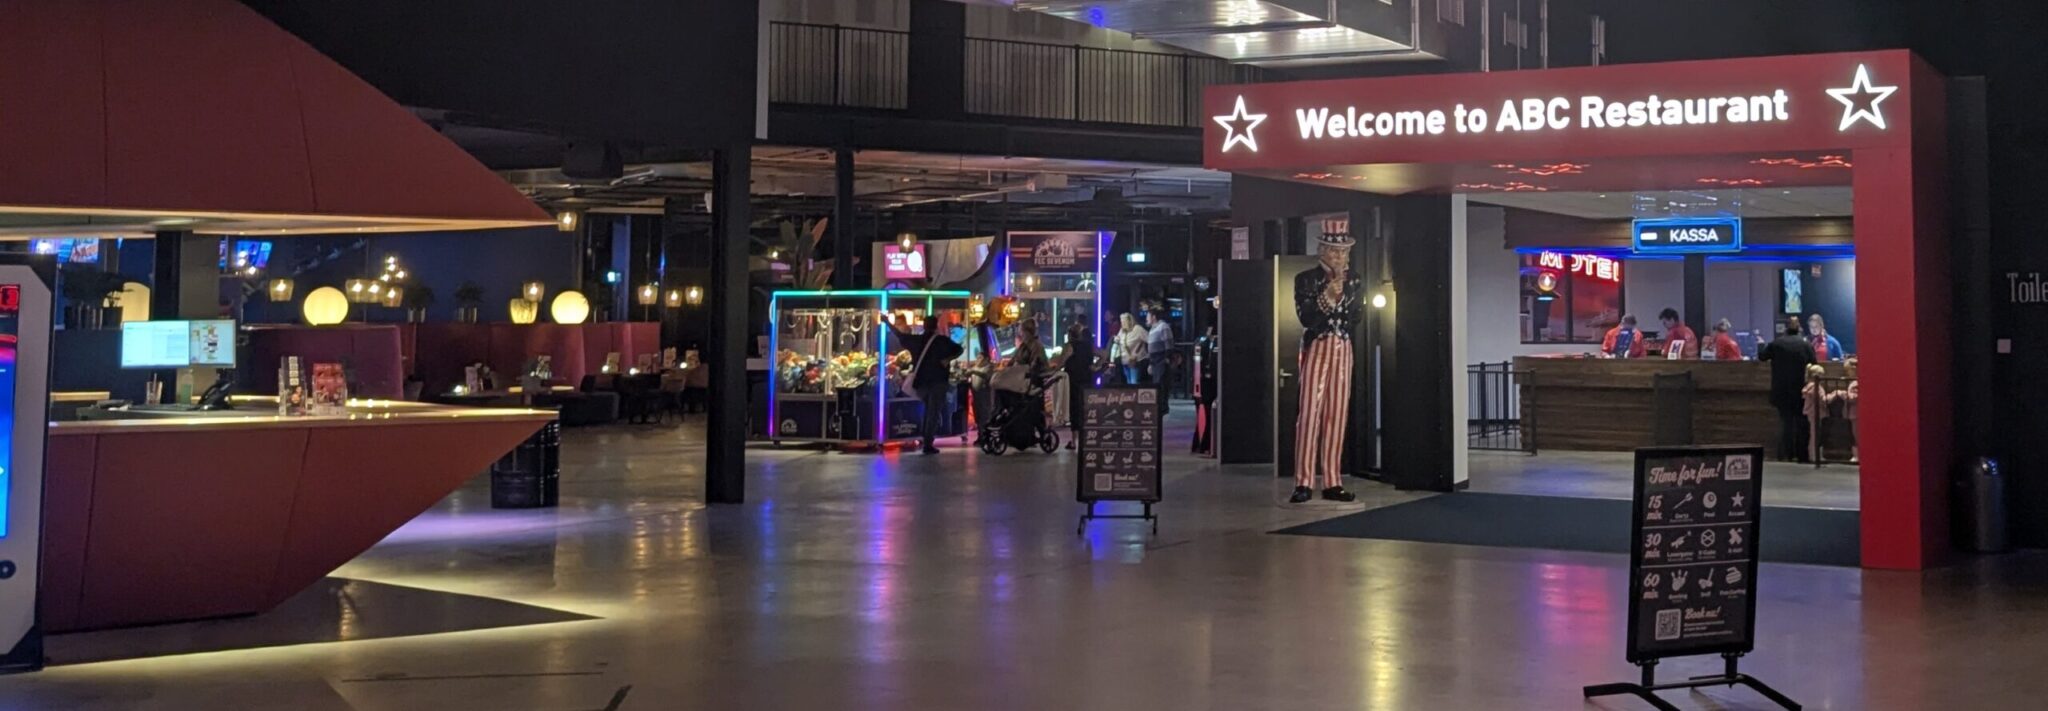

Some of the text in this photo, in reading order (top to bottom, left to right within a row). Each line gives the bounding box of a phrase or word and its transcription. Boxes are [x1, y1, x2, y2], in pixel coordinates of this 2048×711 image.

[1296, 89, 1788, 139] Welcome to ABC Restaurant
[1669, 228, 1719, 242] KASSA
[1107, 392, 1119, 406] for
[1649, 466, 1677, 484] Time
[1677, 464, 1696, 486] for
[1696, 462, 1723, 484] fun!
[1648, 495, 1662, 509] 15
[1645, 533, 1661, 547] 30
[1643, 572, 1660, 587] 60
[1684, 607, 1706, 619] Book
